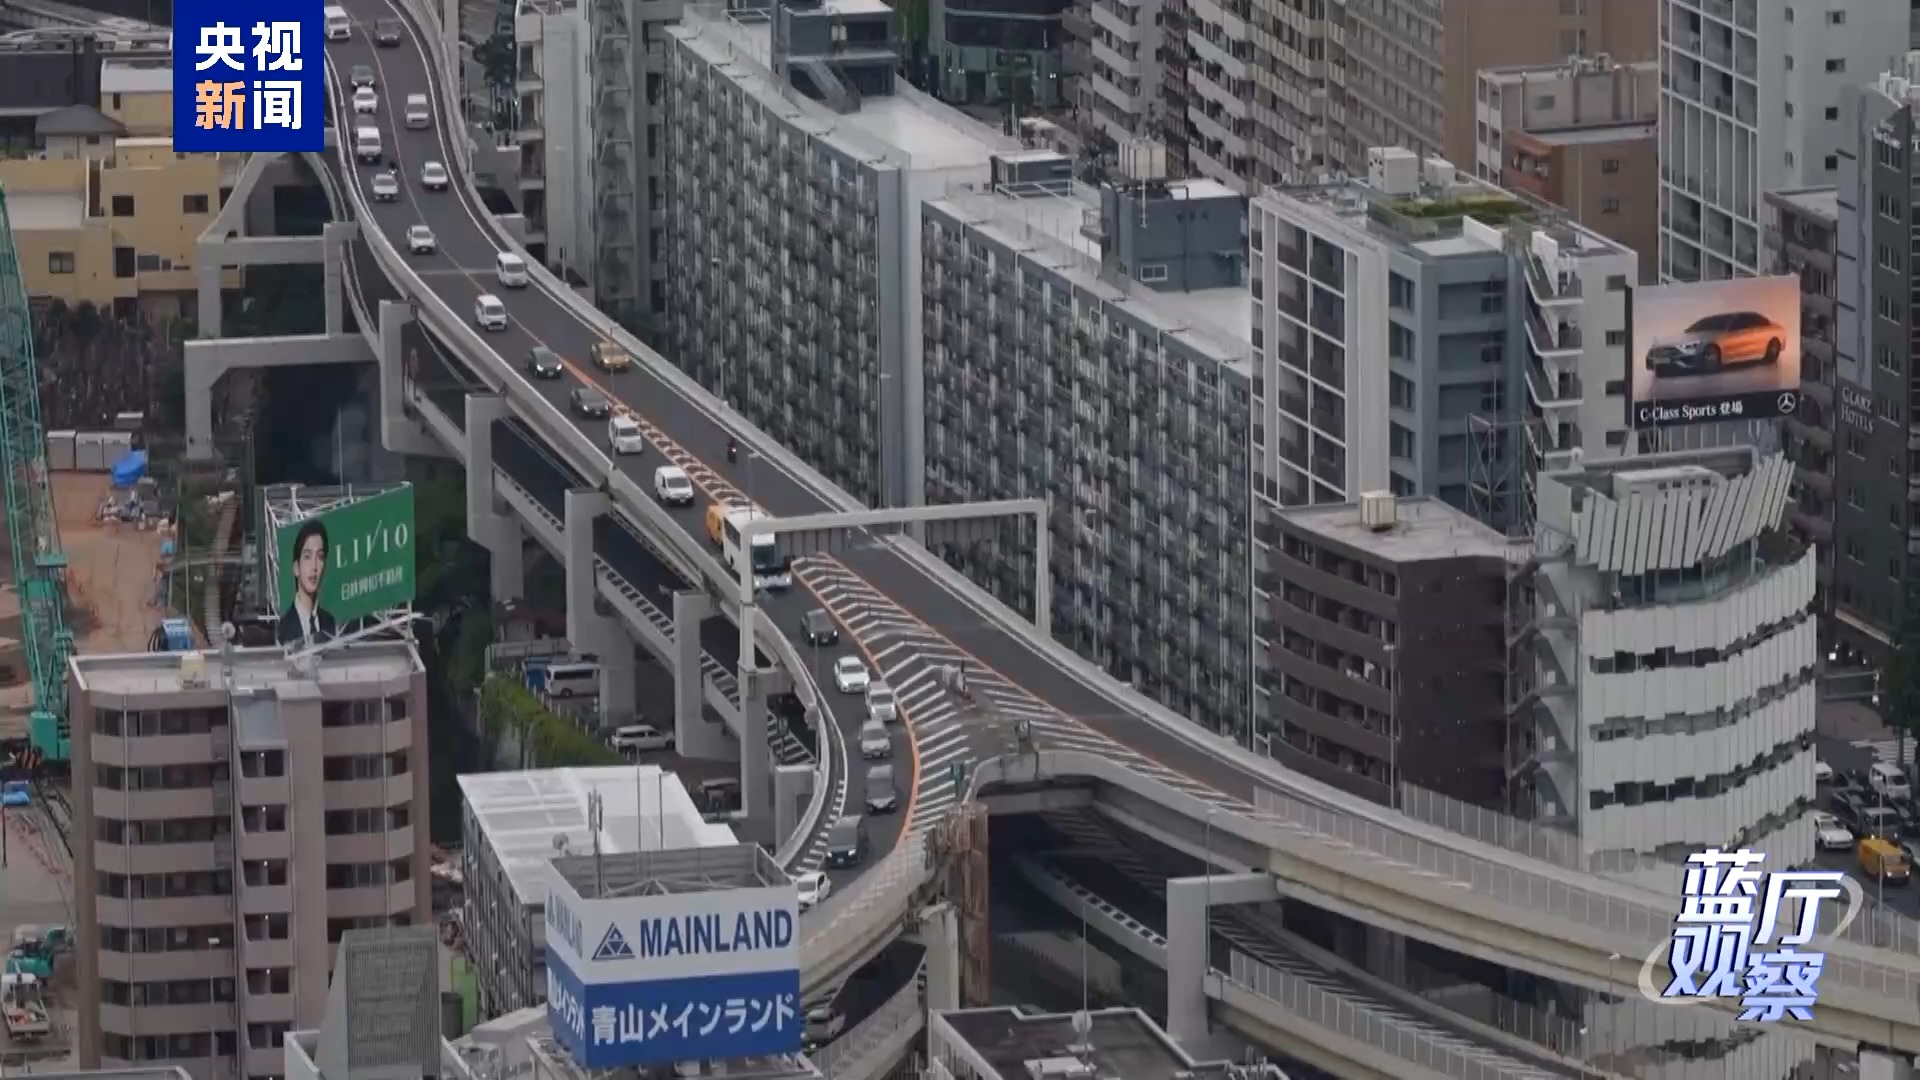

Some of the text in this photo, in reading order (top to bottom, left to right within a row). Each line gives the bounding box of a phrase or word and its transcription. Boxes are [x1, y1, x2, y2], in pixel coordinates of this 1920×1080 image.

[1640, 406, 1680, 422] C-Class
[1682, 403, 1718, 421] Sports
[1841, 402, 1874, 434] HOTELS
[334, 519, 408, 568] LIVIO
[640, 909, 793, 958] MAINLAND
[591, 993, 795, 1046] 青山メインランド
